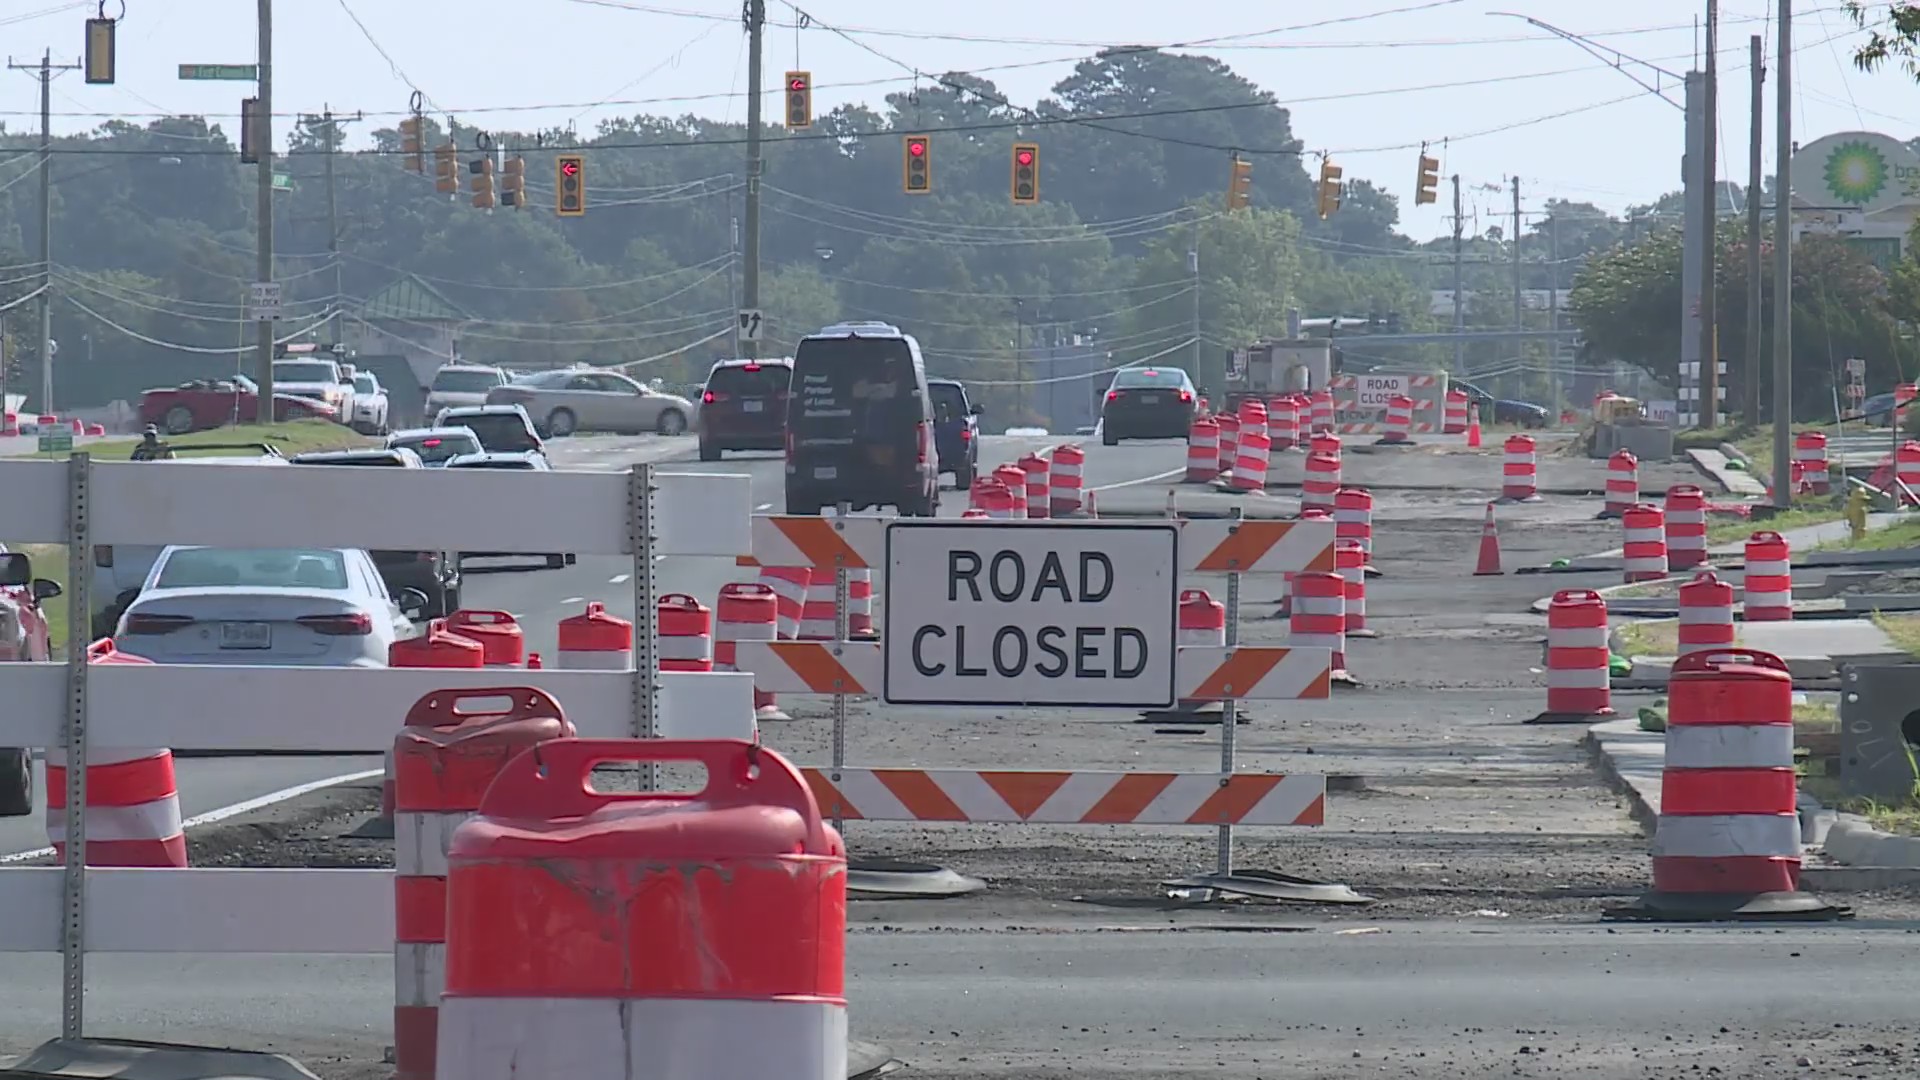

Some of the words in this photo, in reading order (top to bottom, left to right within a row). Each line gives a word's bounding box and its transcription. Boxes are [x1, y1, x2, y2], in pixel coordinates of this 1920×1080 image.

[1361, 393, 1398, 404] CLOS
[1367, 379, 1399, 390] ROAD
[948, 549, 1115, 603] ROAD
[912, 624, 1149, 679] CLOSED
